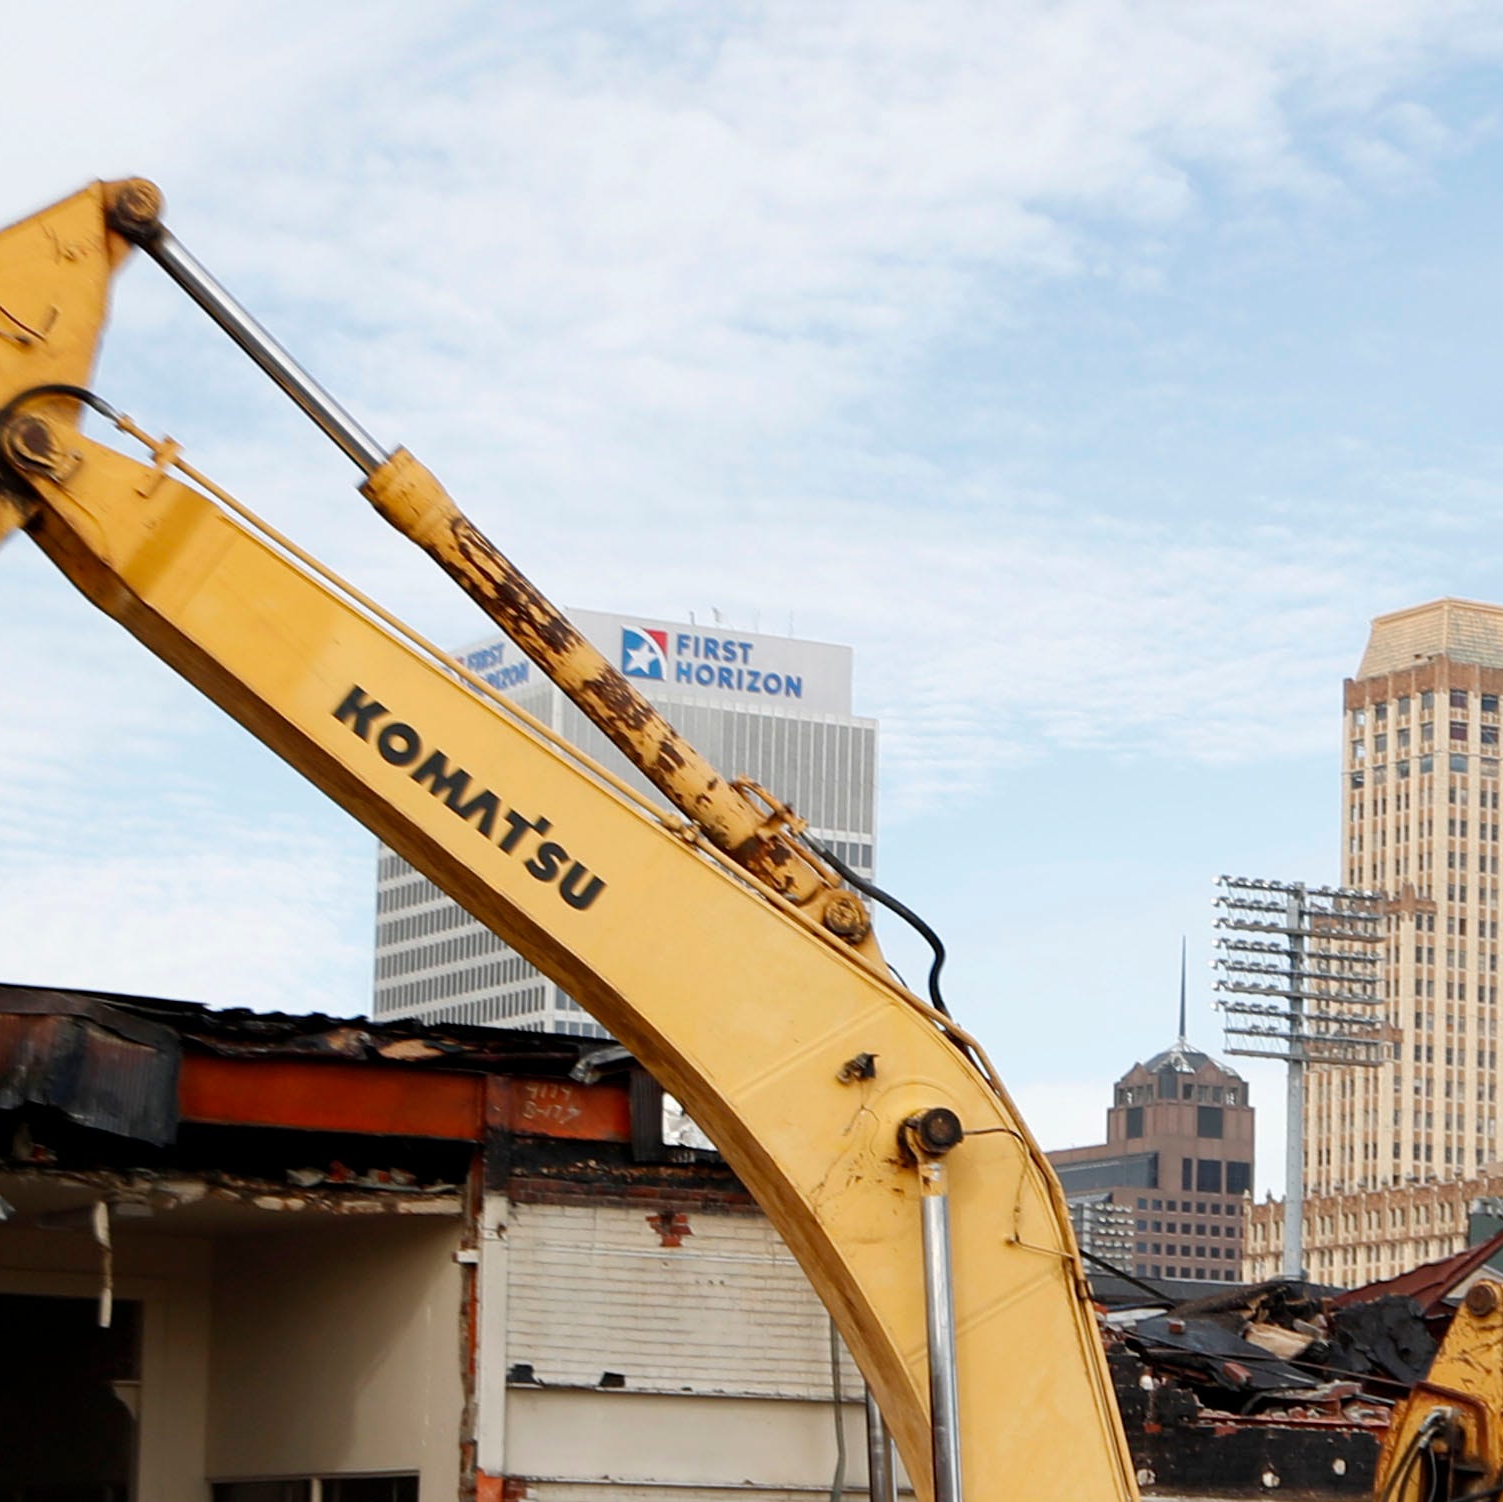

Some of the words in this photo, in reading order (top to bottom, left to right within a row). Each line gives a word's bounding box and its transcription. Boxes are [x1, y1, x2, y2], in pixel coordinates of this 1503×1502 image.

[676, 632, 754, 665] FIRST
[675, 660, 803, 698] HORIZON
[332, 683, 609, 912] KOMATSU
